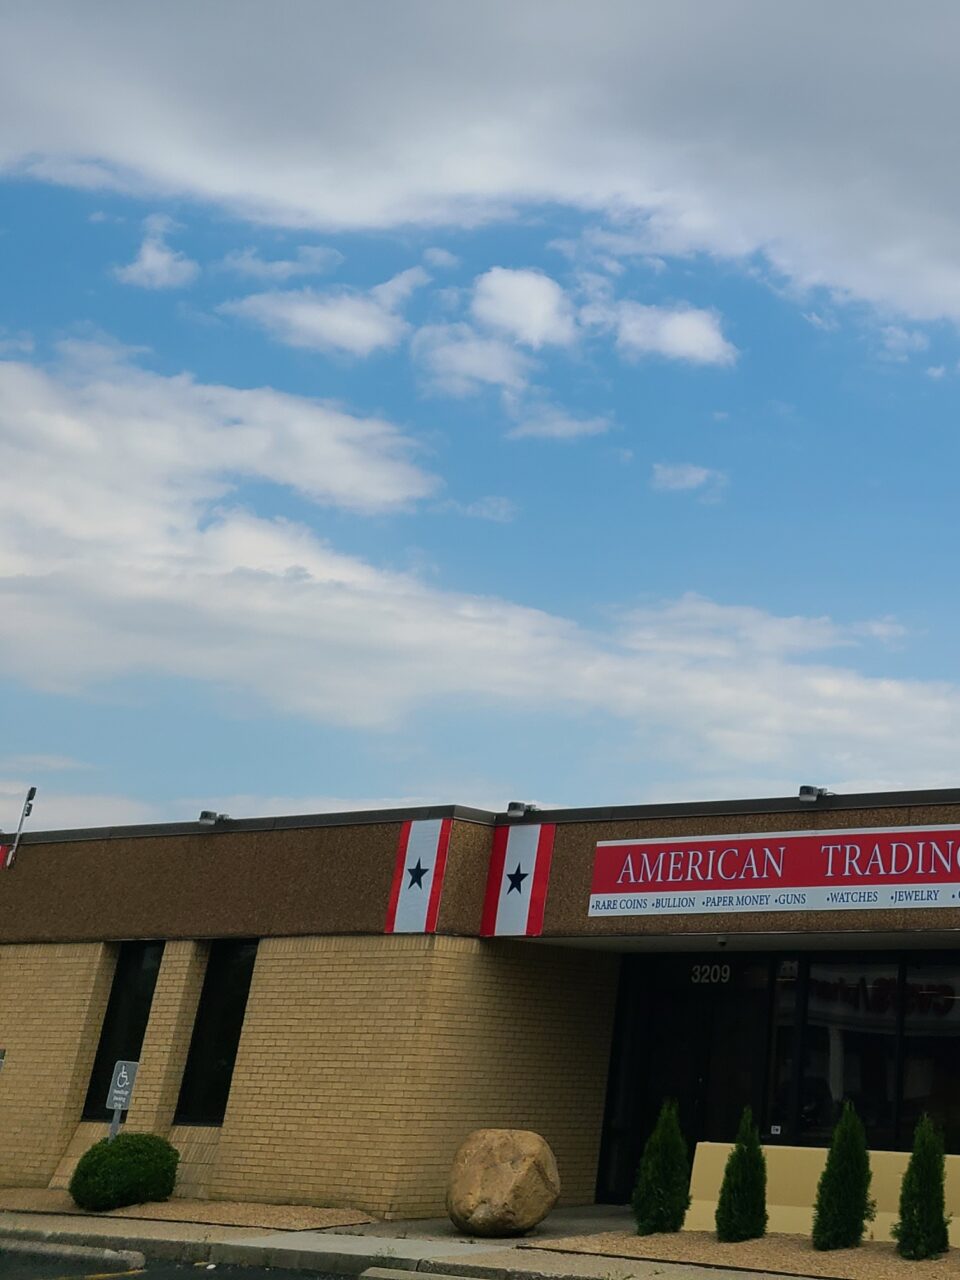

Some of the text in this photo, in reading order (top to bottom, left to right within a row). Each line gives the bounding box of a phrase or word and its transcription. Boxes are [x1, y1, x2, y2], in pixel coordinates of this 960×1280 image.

[616, 847, 786, 883] AMERICAN
[594, 900, 618, 910] RARE
[619, 898, 648, 909] COINS
[655, 897, 696, 908] BULLION
[705, 895, 735, 907] PAPER
[736, 894, 771, 906] MONEY
[778, 893, 806, 905] GUNS
[830, 891, 878, 903] WATCHES
[894, 890, 940, 904] JEWELRY
[691, 964, 730, 983] 3209
